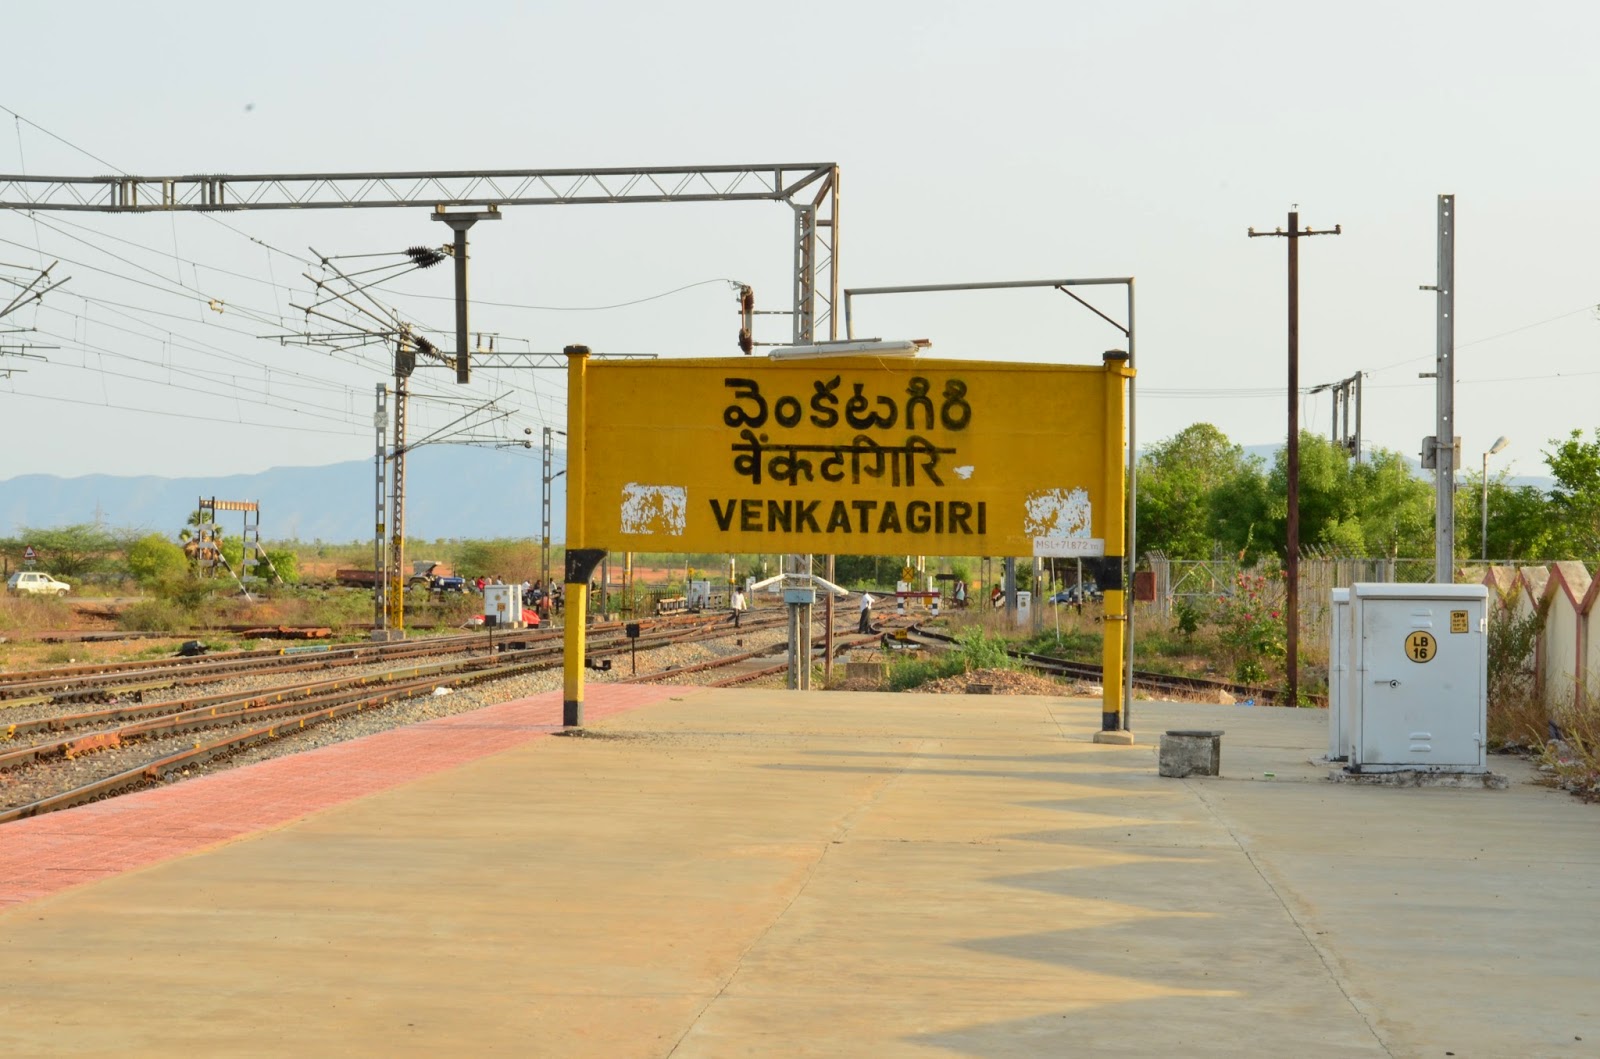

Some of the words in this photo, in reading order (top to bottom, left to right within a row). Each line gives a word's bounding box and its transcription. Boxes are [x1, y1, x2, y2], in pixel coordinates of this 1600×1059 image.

[731, 429, 957, 487] वेंकटगिरि
[709, 499, 987, 535] VENKATAGIRI
[1413, 636, 1428, 647] LB
[1413, 647, 1427, 659] 16
